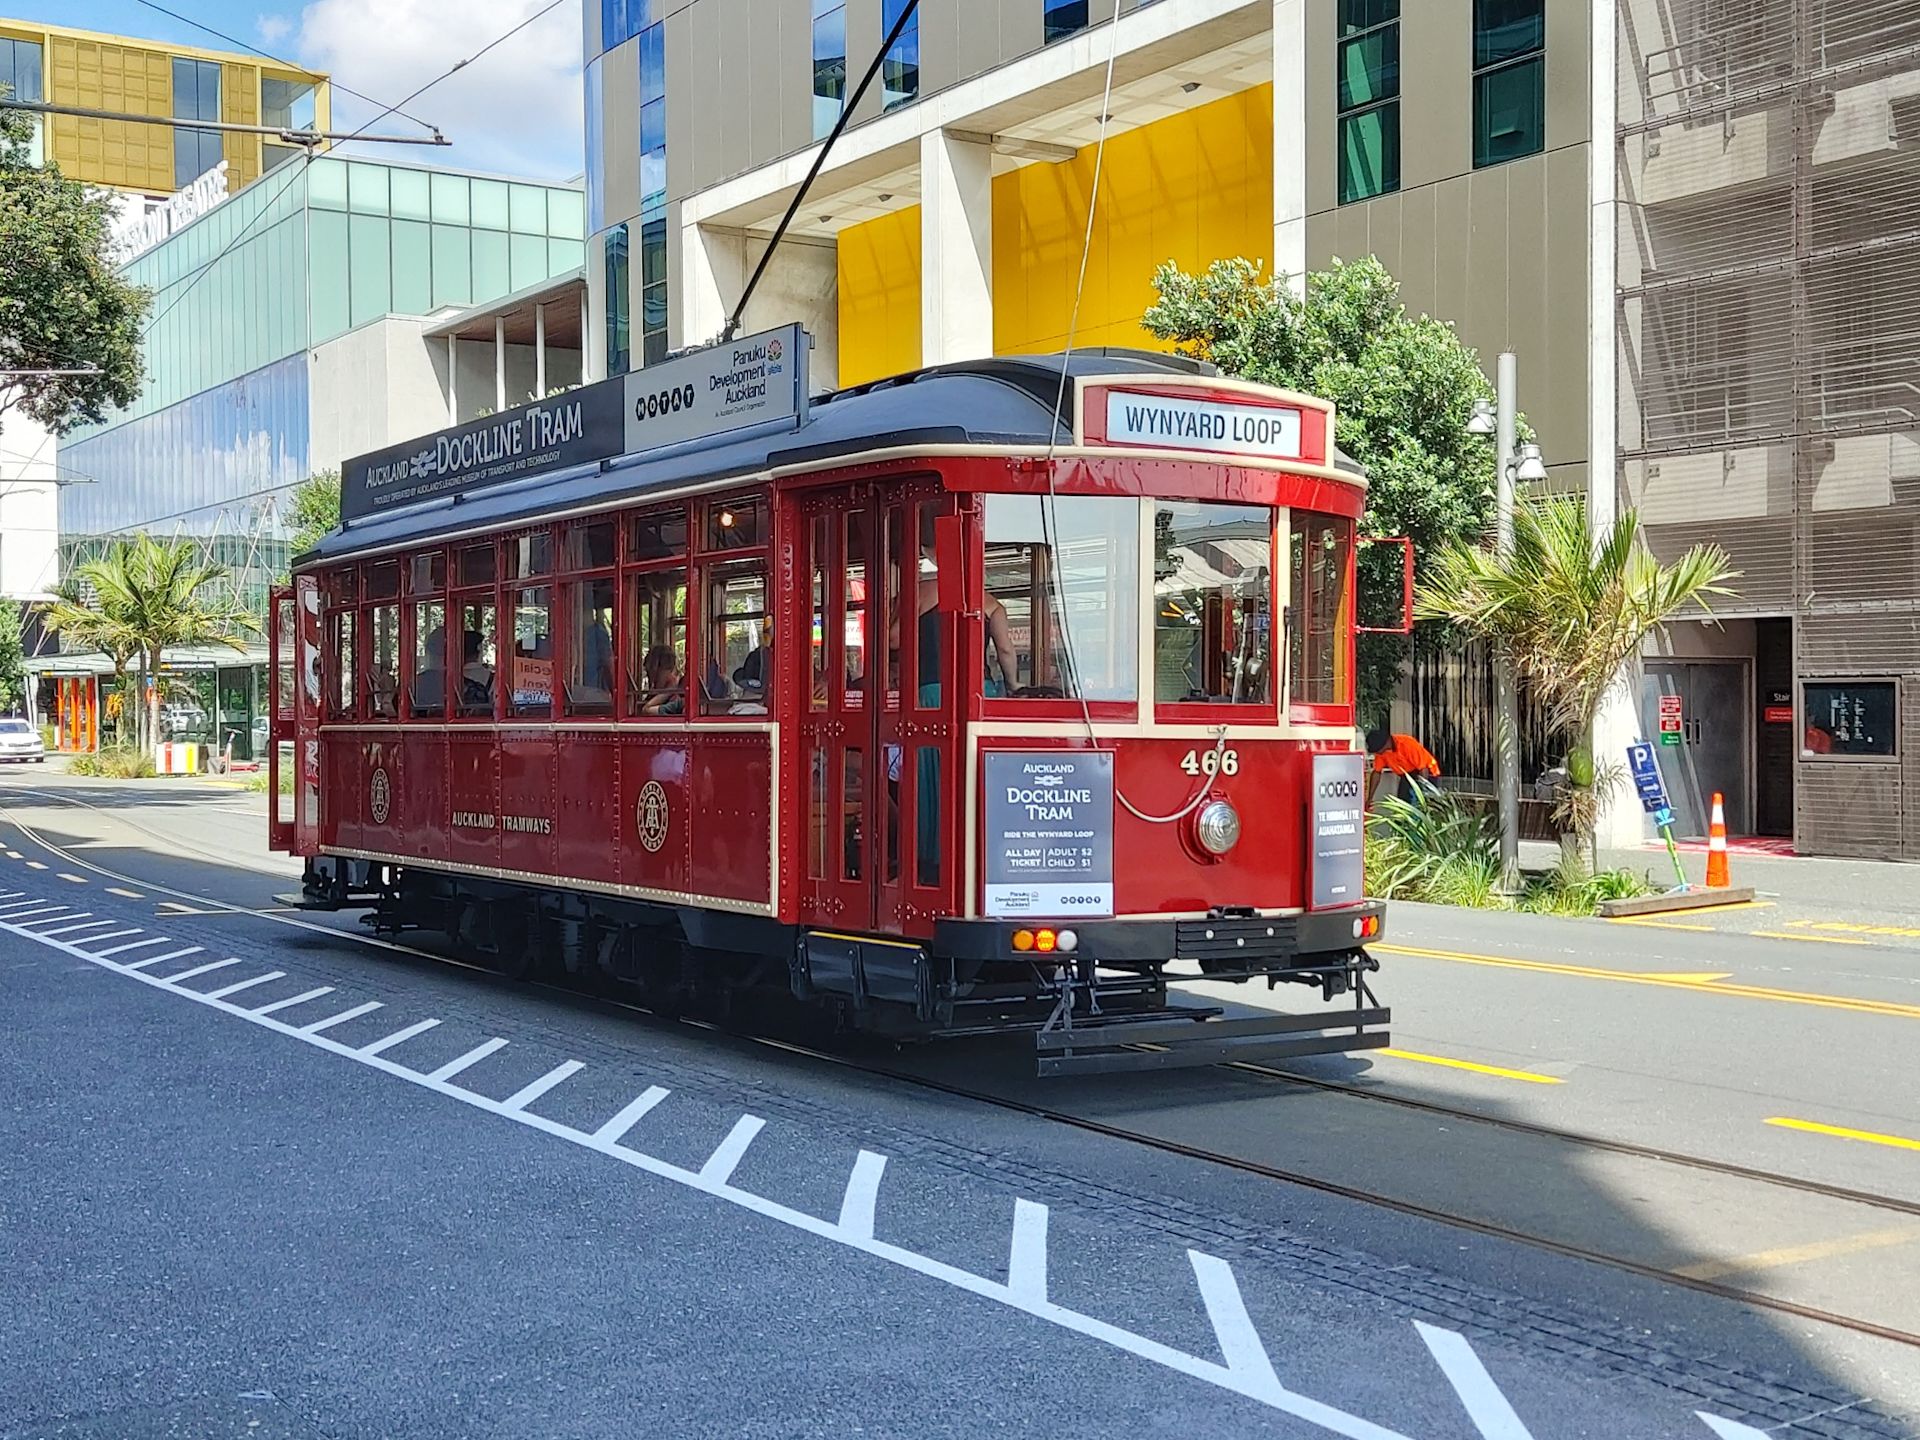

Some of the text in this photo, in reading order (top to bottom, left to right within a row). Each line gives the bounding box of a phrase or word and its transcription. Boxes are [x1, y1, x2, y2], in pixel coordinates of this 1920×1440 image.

[733, 345, 766, 367] Panuku
[709, 363, 766, 391] Development
[725, 379, 766, 404] Auckland
[1125, 406, 1283, 445] WYNYARD LOOP
[366, 402, 584, 489] AUCKLAND DOCKLINE TRAM
[1023, 763, 1075, 773] AUCKLAND
[1180, 749, 1239, 776] 466
[1634, 747, 1648, 770] P
[1006, 787, 1092, 803] DOCKLINE
[1025, 804, 1073, 820] TRAM
[452, 811, 551, 835] AUCKLAND TRAMWAYS
[1074, 830, 1094, 838] LOOP
[1005, 849, 1041, 857] ALL DAY
[1047, 847, 1093, 856] ADULT $2
[1010, 859, 1041, 867] TICKET
[1047, 858, 1091, 867] CHILD $1
